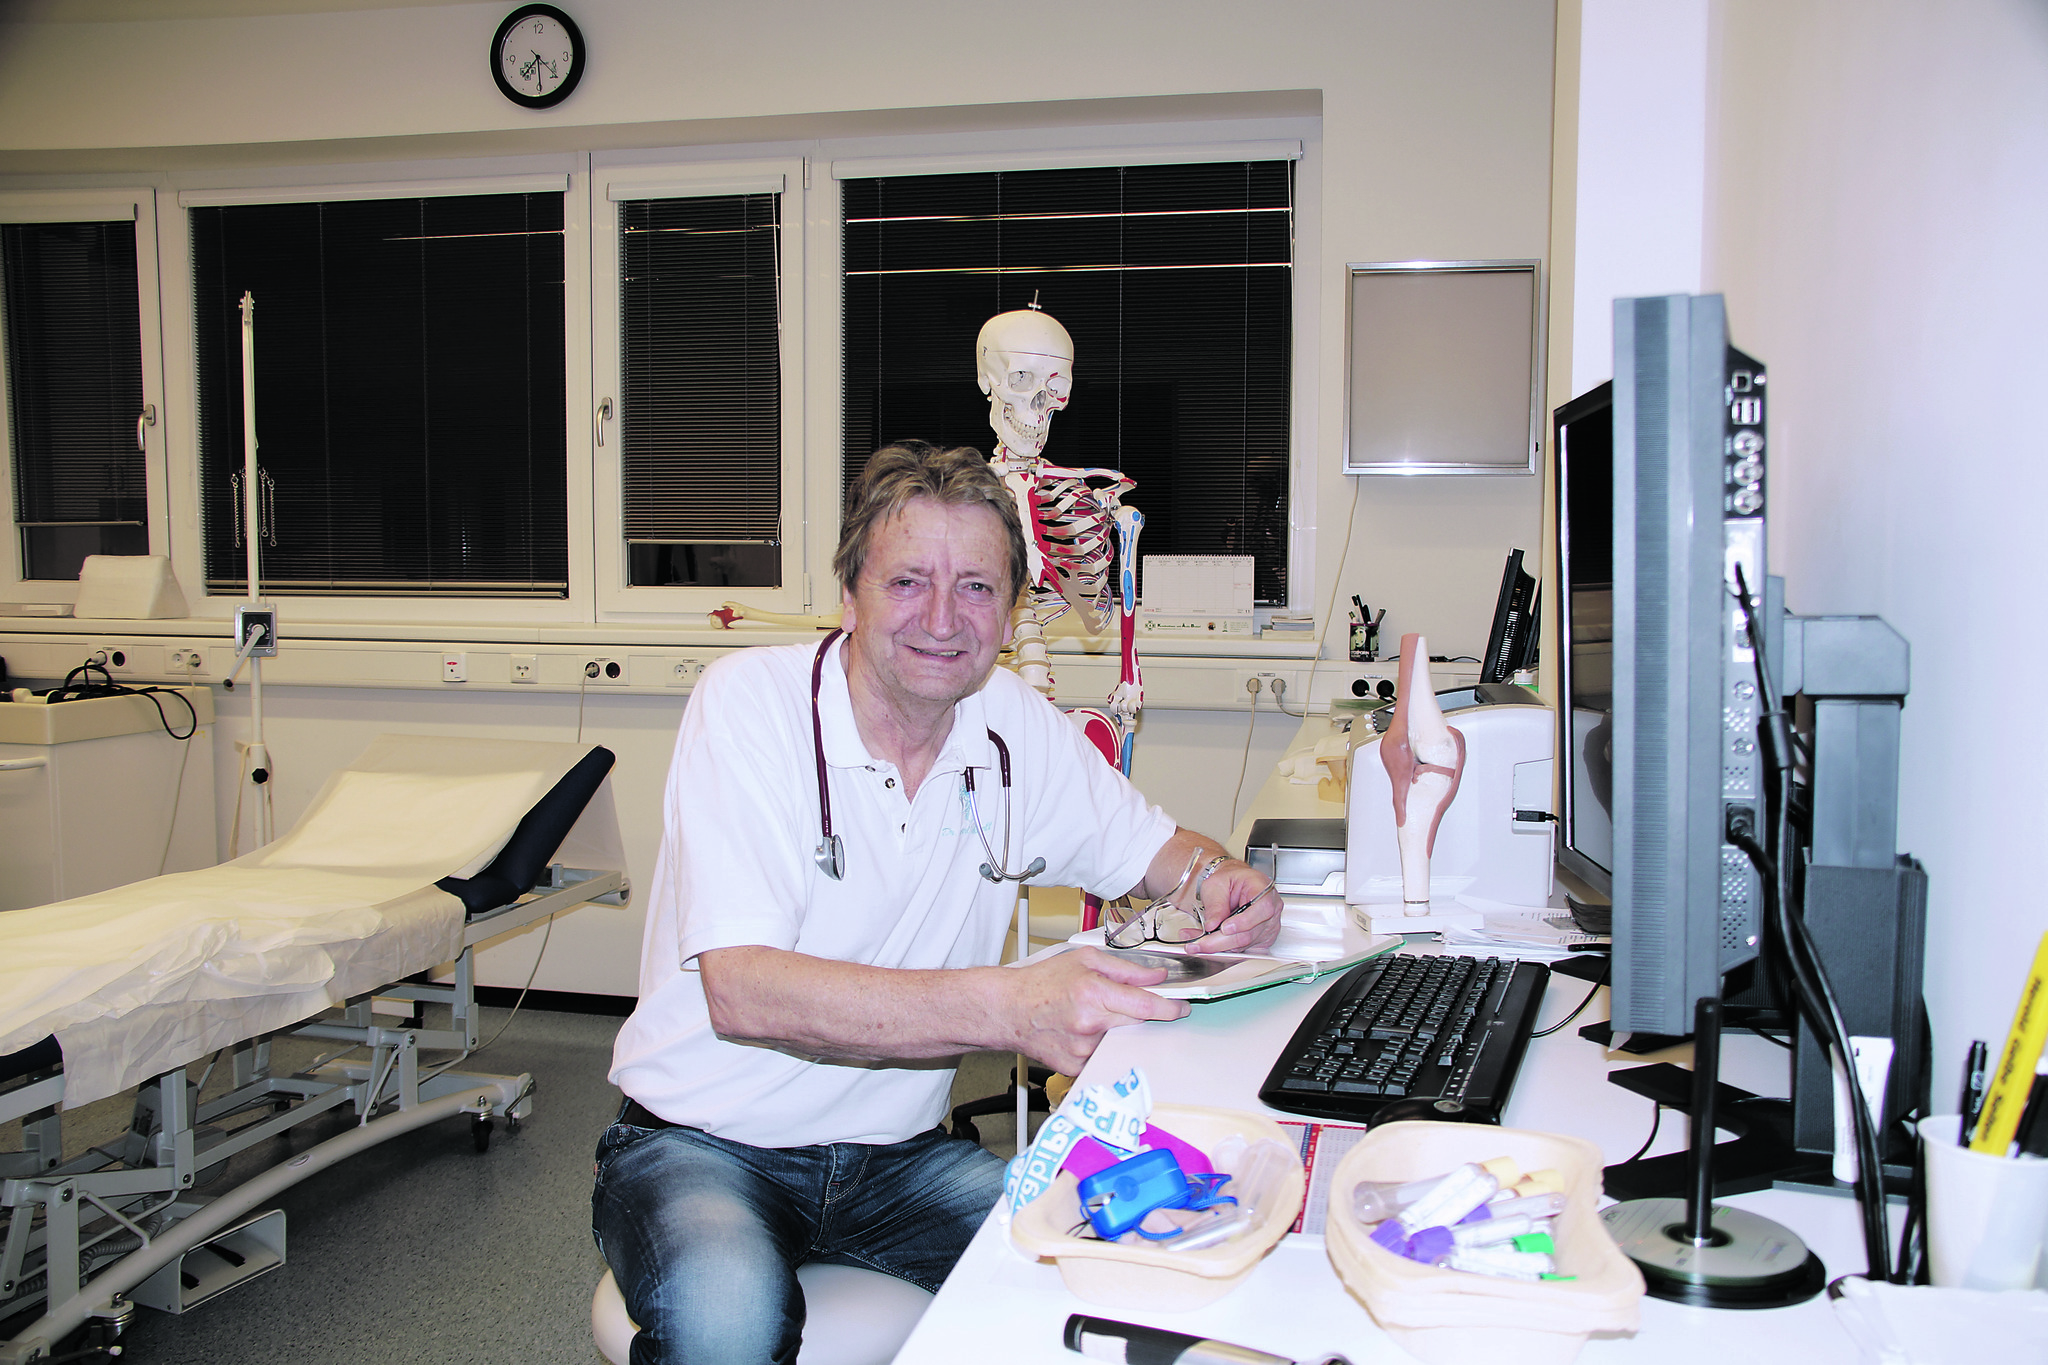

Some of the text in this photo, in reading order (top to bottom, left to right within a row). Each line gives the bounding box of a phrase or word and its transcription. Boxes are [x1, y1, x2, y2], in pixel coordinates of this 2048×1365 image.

[533, 23, 543, 34] 12
[509, 54, 516, 65] 9
[562, 51, 569, 62] 3
